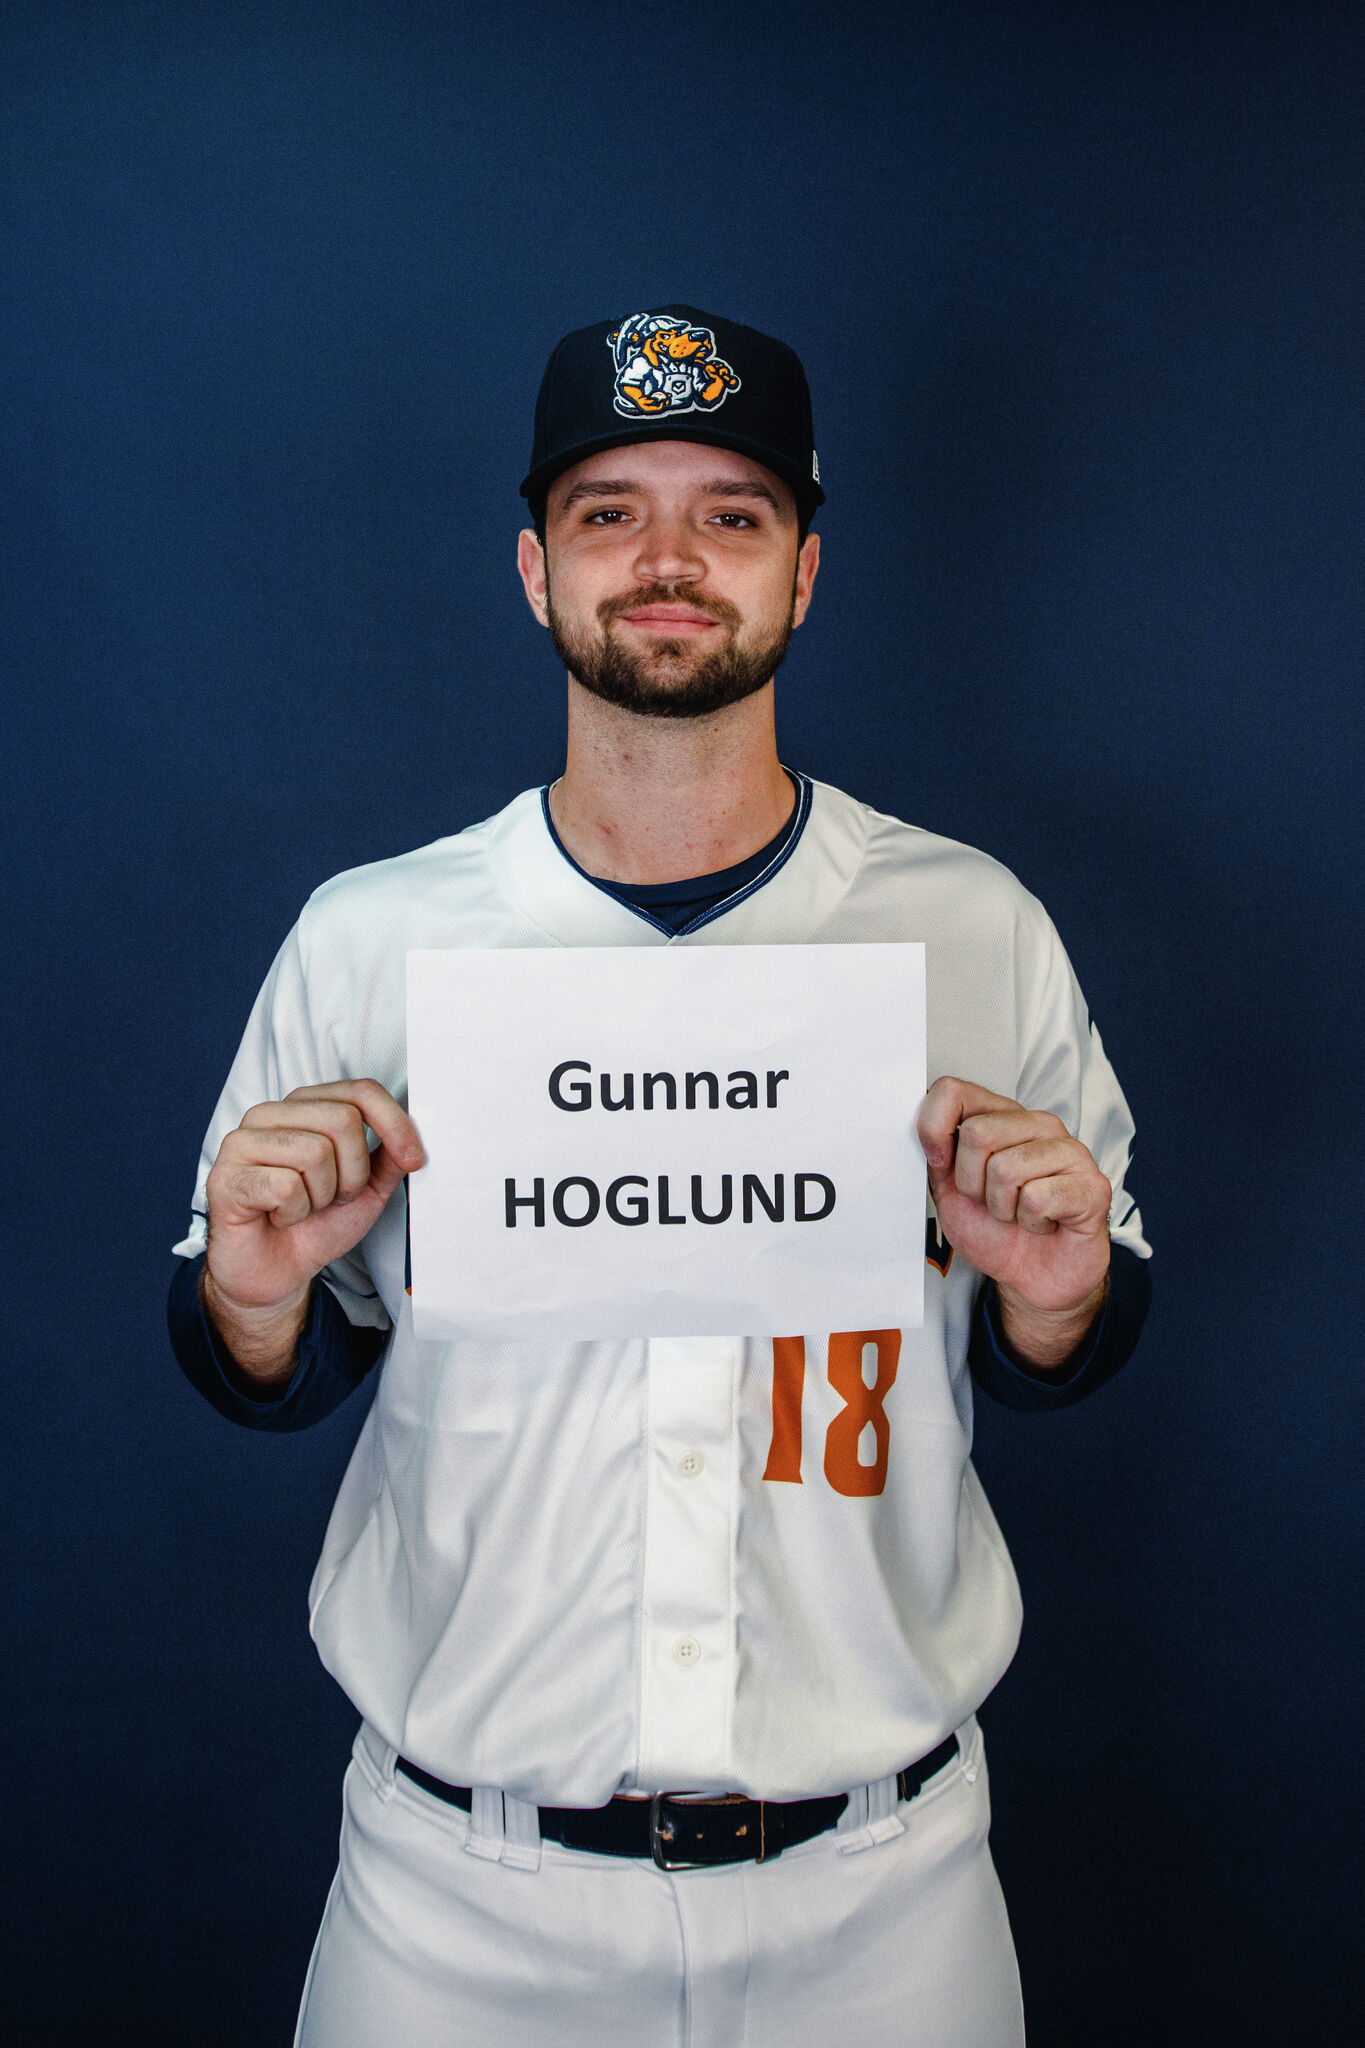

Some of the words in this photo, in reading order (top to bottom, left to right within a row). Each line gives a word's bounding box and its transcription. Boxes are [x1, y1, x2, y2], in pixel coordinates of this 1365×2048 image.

[548, 1060, 790, 1111] Gunnar
[504, 1172, 836, 1227] HOGLUND
[762, 1329, 902, 1497] 18
